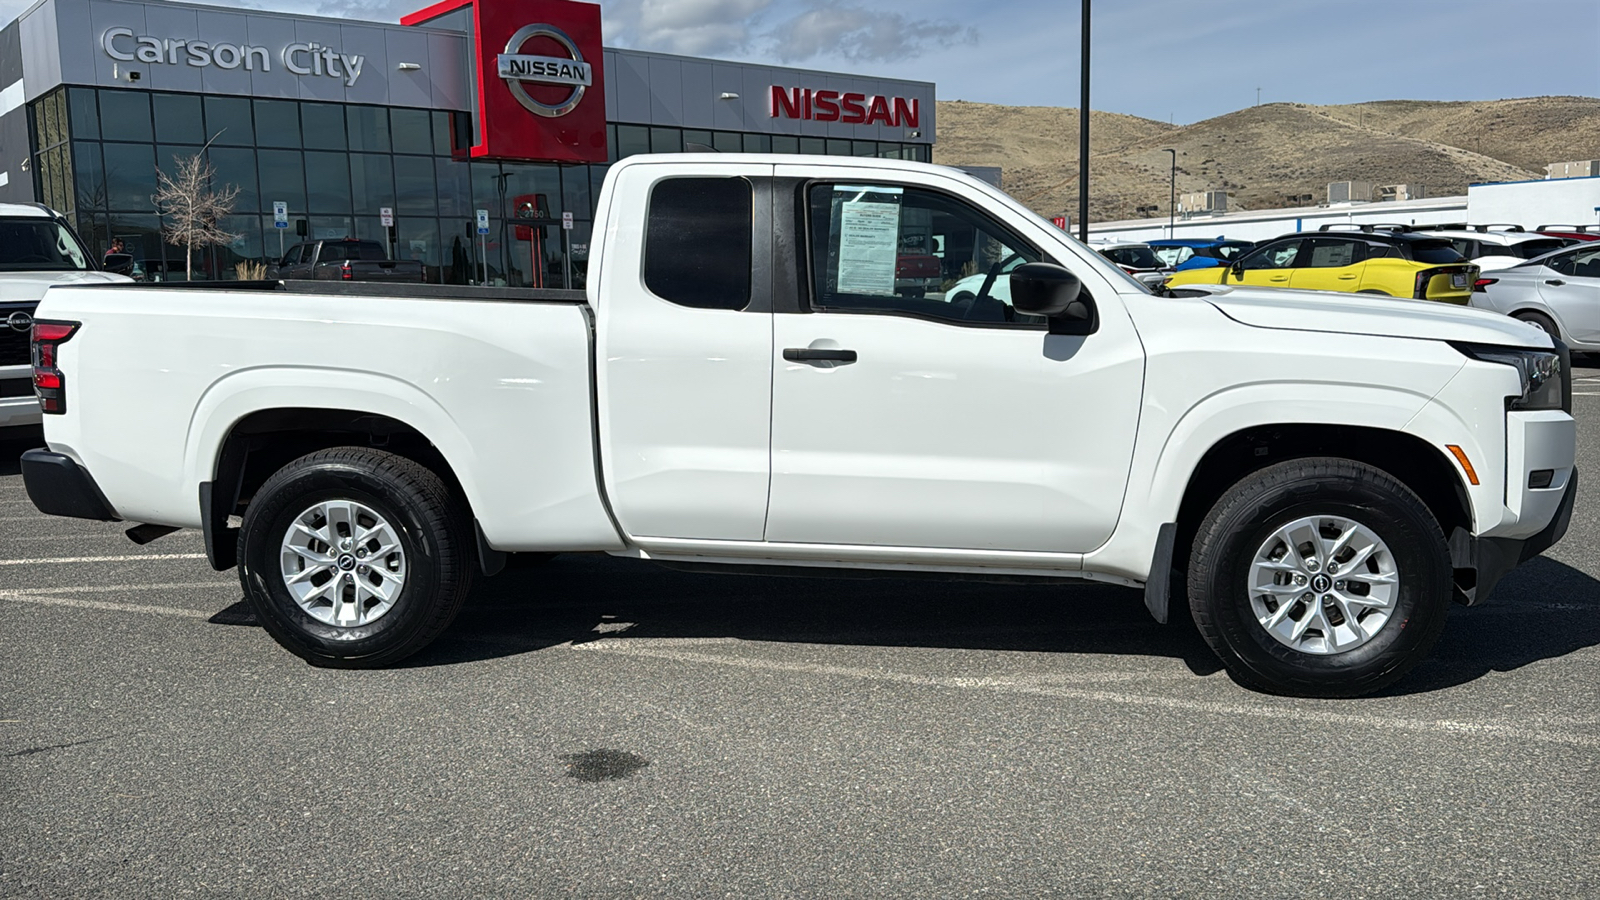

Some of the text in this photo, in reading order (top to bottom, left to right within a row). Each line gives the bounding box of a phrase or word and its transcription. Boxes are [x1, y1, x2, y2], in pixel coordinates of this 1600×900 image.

[102, 27, 365, 87] Carson City
[509, 60, 585, 81] NISSAN
[769, 85, 919, 128] NISSAN
[524, 209, 544, 218] 2750
